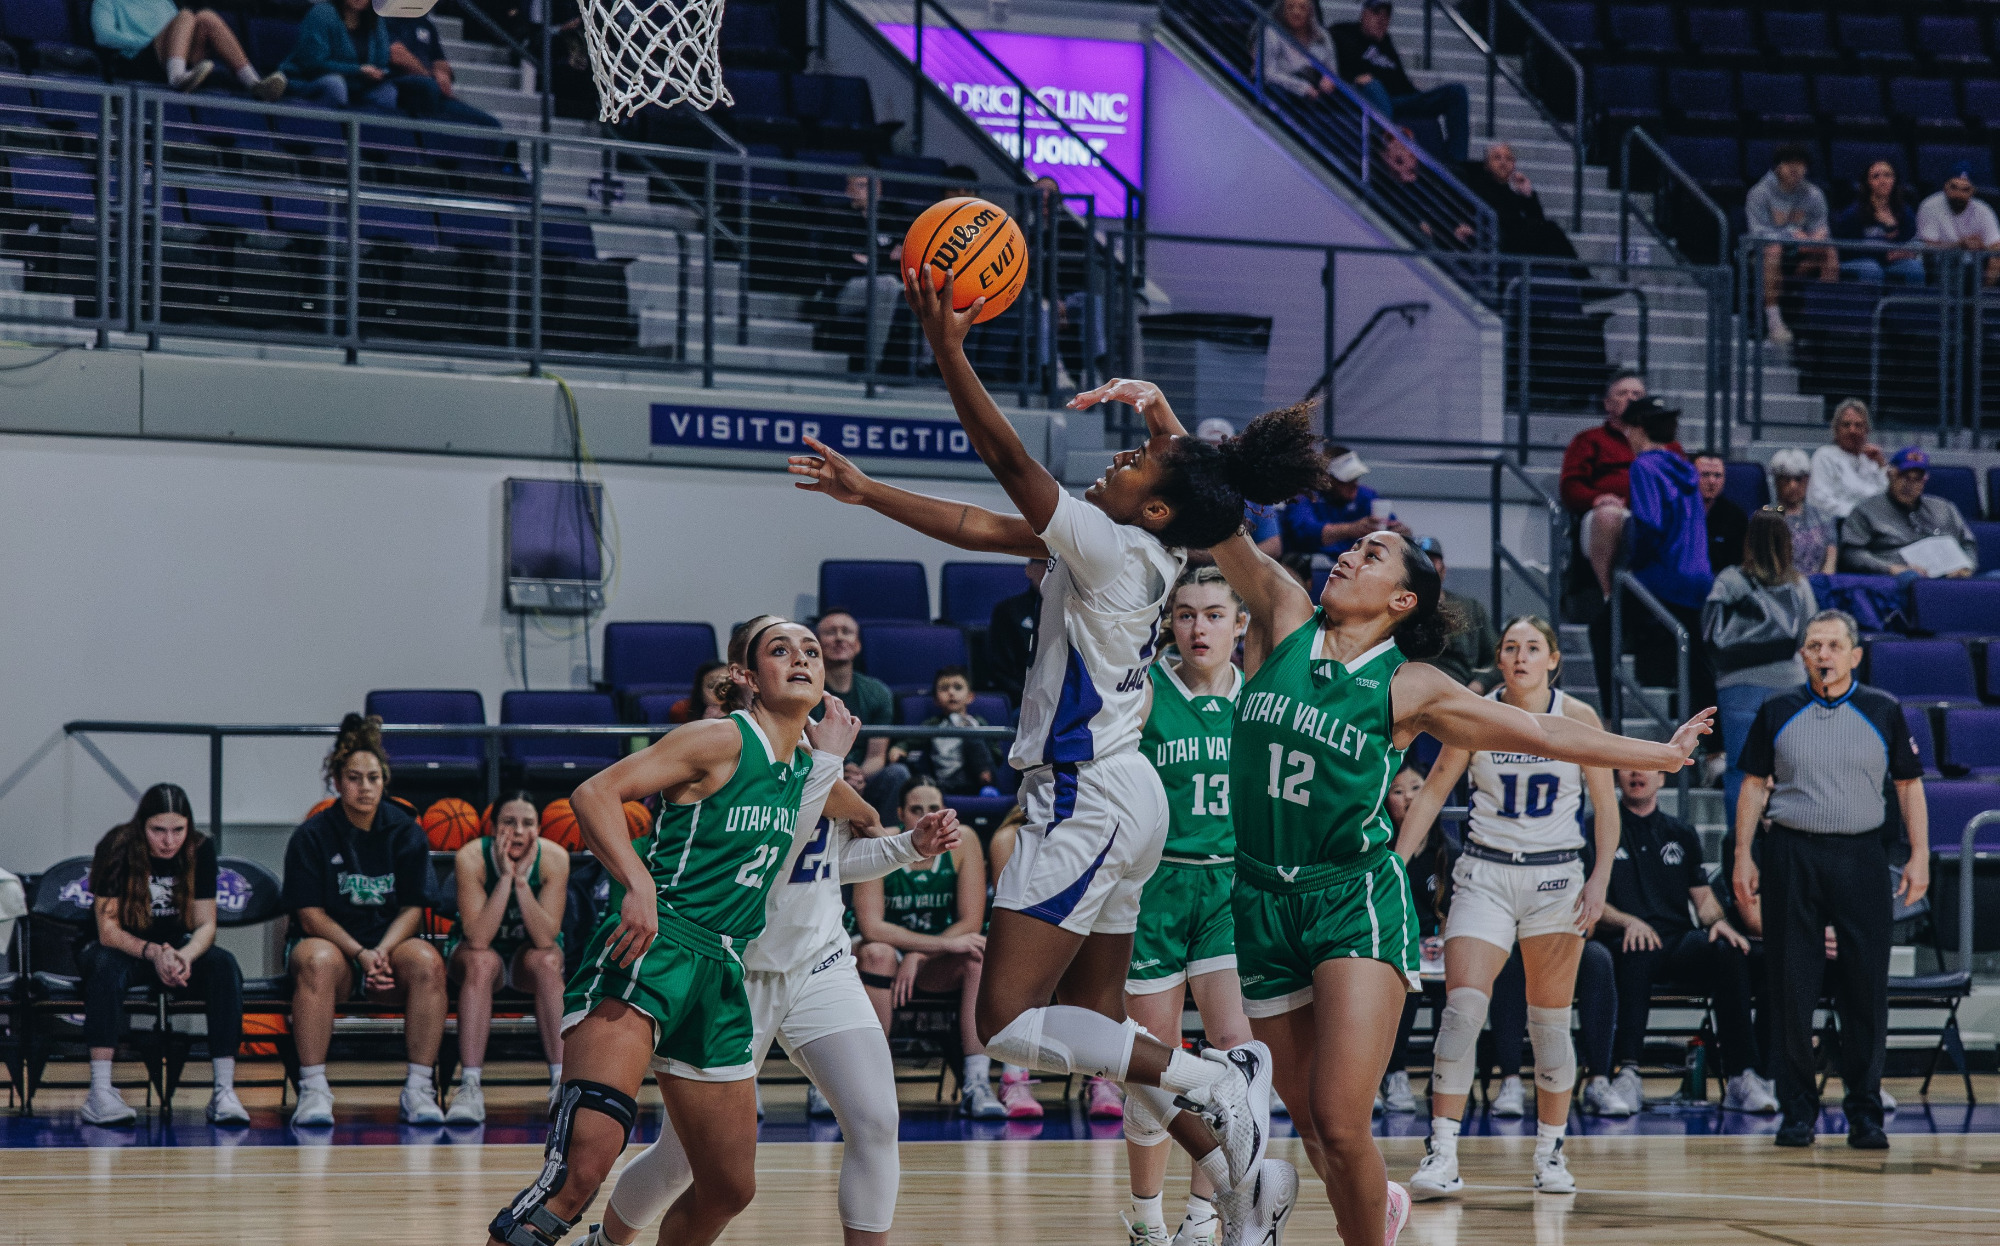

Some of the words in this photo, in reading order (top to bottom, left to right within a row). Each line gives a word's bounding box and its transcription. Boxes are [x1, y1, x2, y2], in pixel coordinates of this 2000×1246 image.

[1036, 86, 1129, 123] CLINIC
[930, 208, 998, 272] Wilson
[979, 242, 1015, 289] EVO
[669, 412, 821, 446] VISITOR
[841, 424, 970, 453] SECTIO
[1116, 663, 1150, 692] JAC
[1242, 692, 1291, 725] UTAH
[1292, 702, 1368, 761] VALLEY
[1157, 737, 1199, 767] UTAH
[1192, 773, 1230, 816] 13
[1267, 742, 1316, 807] 12
[1496, 773, 1560, 818] 10
[725, 805, 772, 832] UTAH
[735, 843, 780, 889] 21
[1537, 878, 1569, 892] ACU
